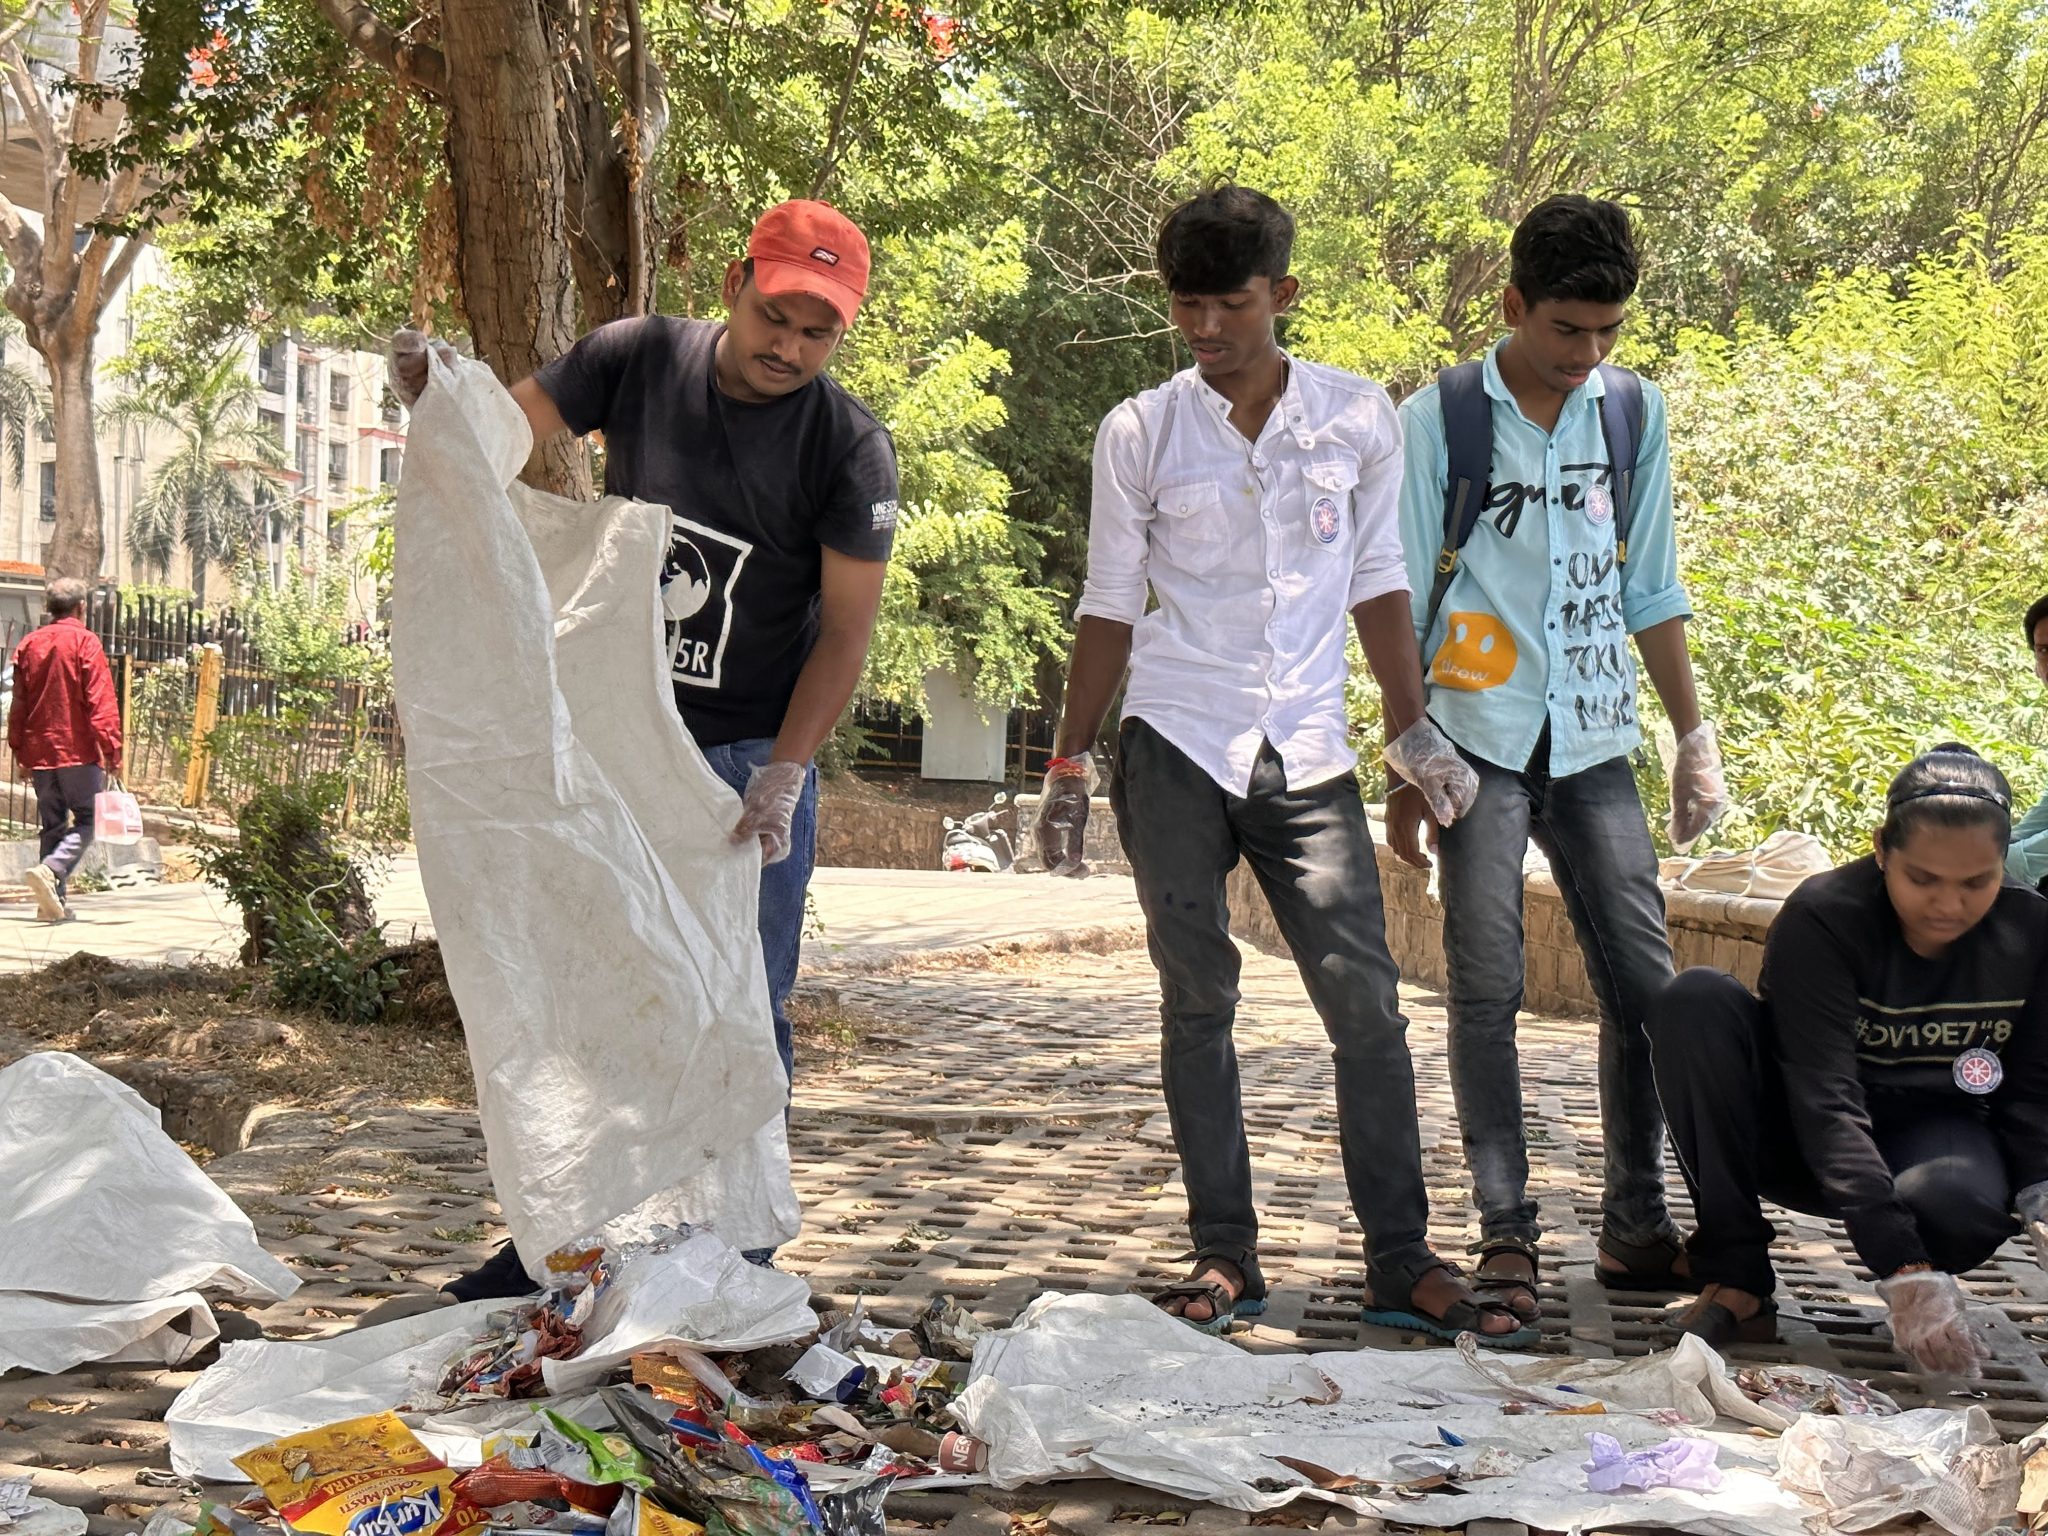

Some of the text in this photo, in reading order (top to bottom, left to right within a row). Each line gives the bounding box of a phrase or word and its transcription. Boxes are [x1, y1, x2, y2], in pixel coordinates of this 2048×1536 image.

[322, 1472, 371, 1495] EXTRA
[382, 1479, 423, 1497] SOLID
[339, 1491, 380, 1514] MASTI
[456, 1505, 479, 1526] 10
